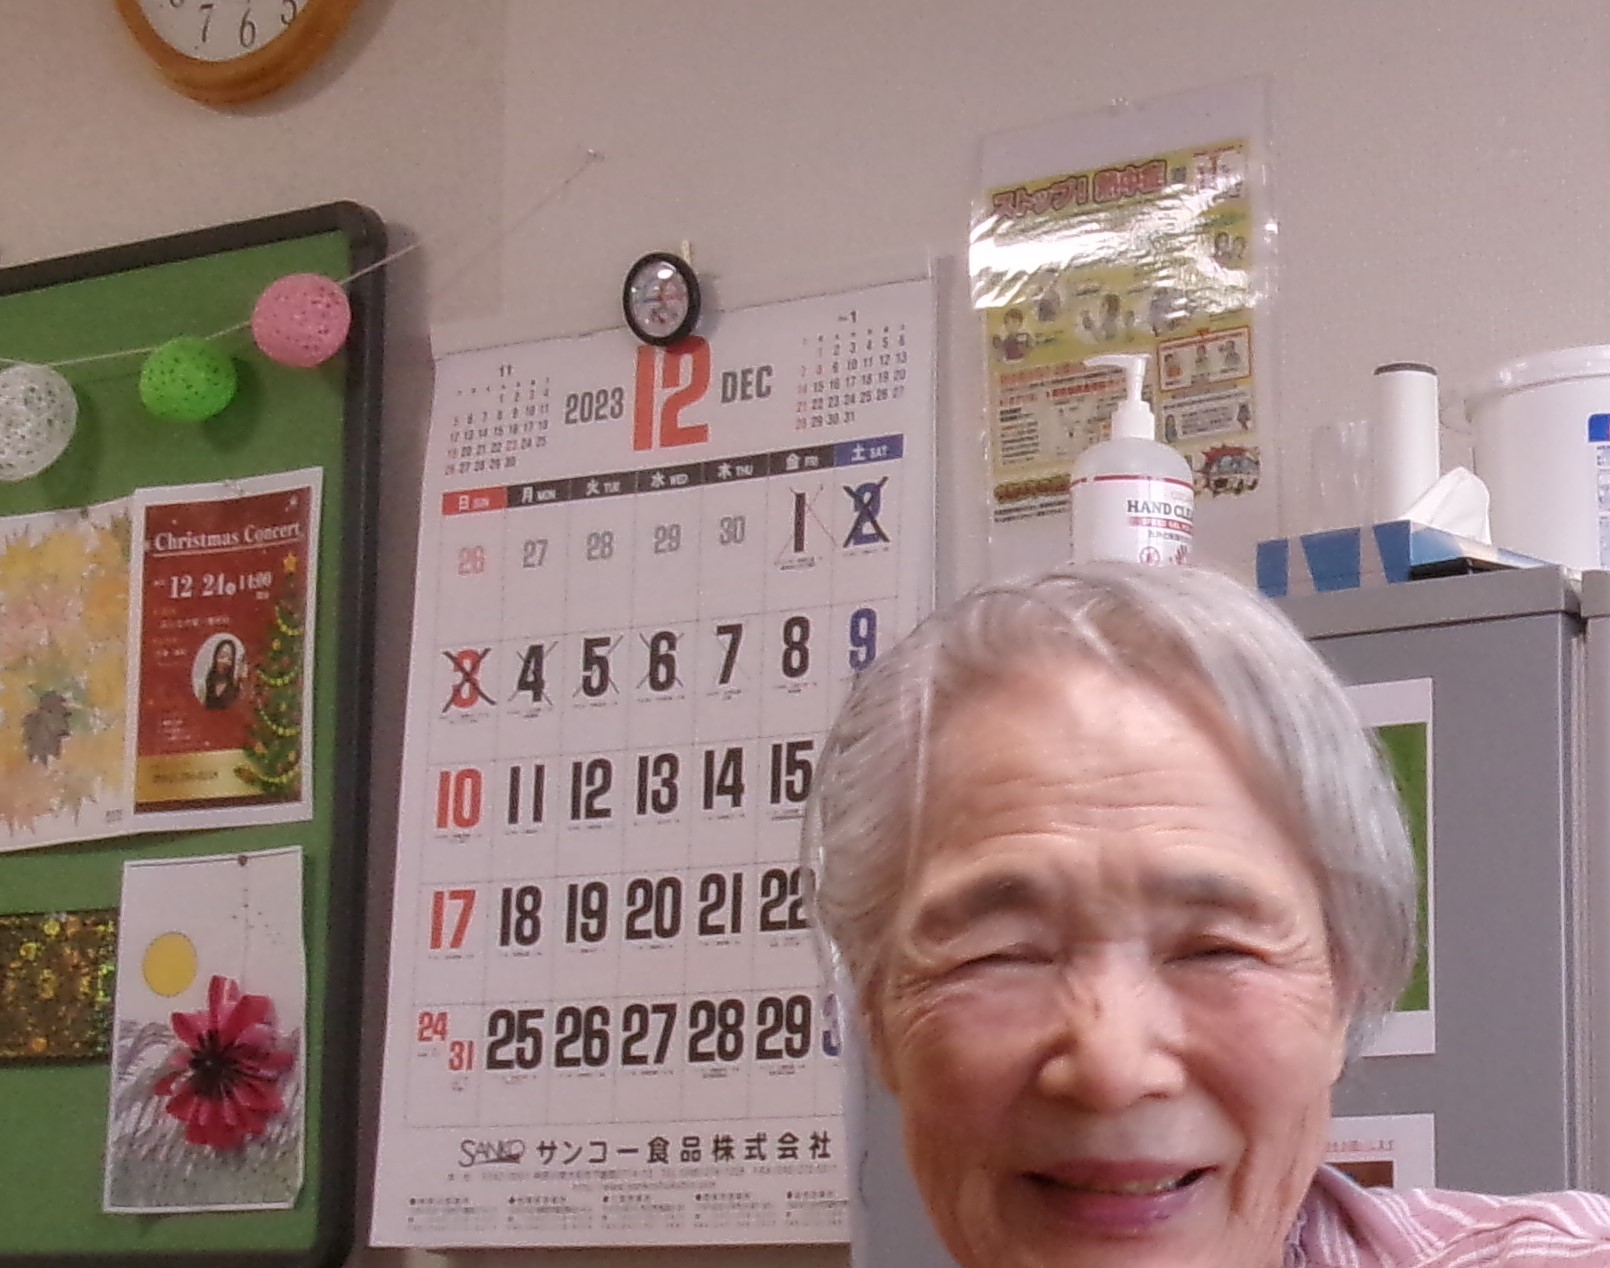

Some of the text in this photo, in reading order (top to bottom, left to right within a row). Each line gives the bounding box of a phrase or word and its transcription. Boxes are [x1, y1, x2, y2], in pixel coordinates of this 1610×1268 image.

[200, 4, 213, 43] 7
[239, 9, 256, 48] 6
[850, 310, 857, 323] 1
[500, 364, 512, 377] 11
[863, 356, 873, 368] 11
[879, 353, 891, 366] 12
[564, 386, 625, 425] 2023
[633, 335, 712, 451] 12
[721, 365, 773, 404] DEC
[845, 375, 857, 388] 17
[843, 411, 855, 423] 31
[459, 495, 470, 510] 日
[522, 487, 534, 503] 月
[537, 489, 556, 501] MON
[586, 480, 599, 496] 火
[604, 482, 620, 493] TUE
[651, 472, 665, 488] 水
[670, 474, 689, 486] WED
[718, 463, 732, 479] 木
[735, 465, 753, 477] THU
[785, 453, 800, 470] 金
[804, 455, 819, 467] FRI
[851, 444, 866, 461] 土
[869, 445, 887, 458] SAT
[1127, 500, 1194, 522] HAND CLE
[154, 521, 301, 552] Christmas Concert
[457, 483, 881, 575] 26 27 28 29 30 1 2
[169, 575, 193, 599] 12
[202, 573, 225, 597] 24
[452, 607, 877, 708] 3 4 5 6 7 8 9
[435, 740, 813, 829] 10 11 12 13 14 15
[429, 868, 815, 950] 17 18 19 20 21 22
[417, 1010, 448, 1042] 24
[486, 1007, 544, 1070] 25
[554, 1005, 610, 1067] 26
[621, 1003, 677, 1066] 27
[688, 999, 744, 1063] 28
[755, 995, 812, 1060] 29
[449, 1040, 474, 1071] 31
[537, 1130, 832, 1166] サンコー食品株式会社
